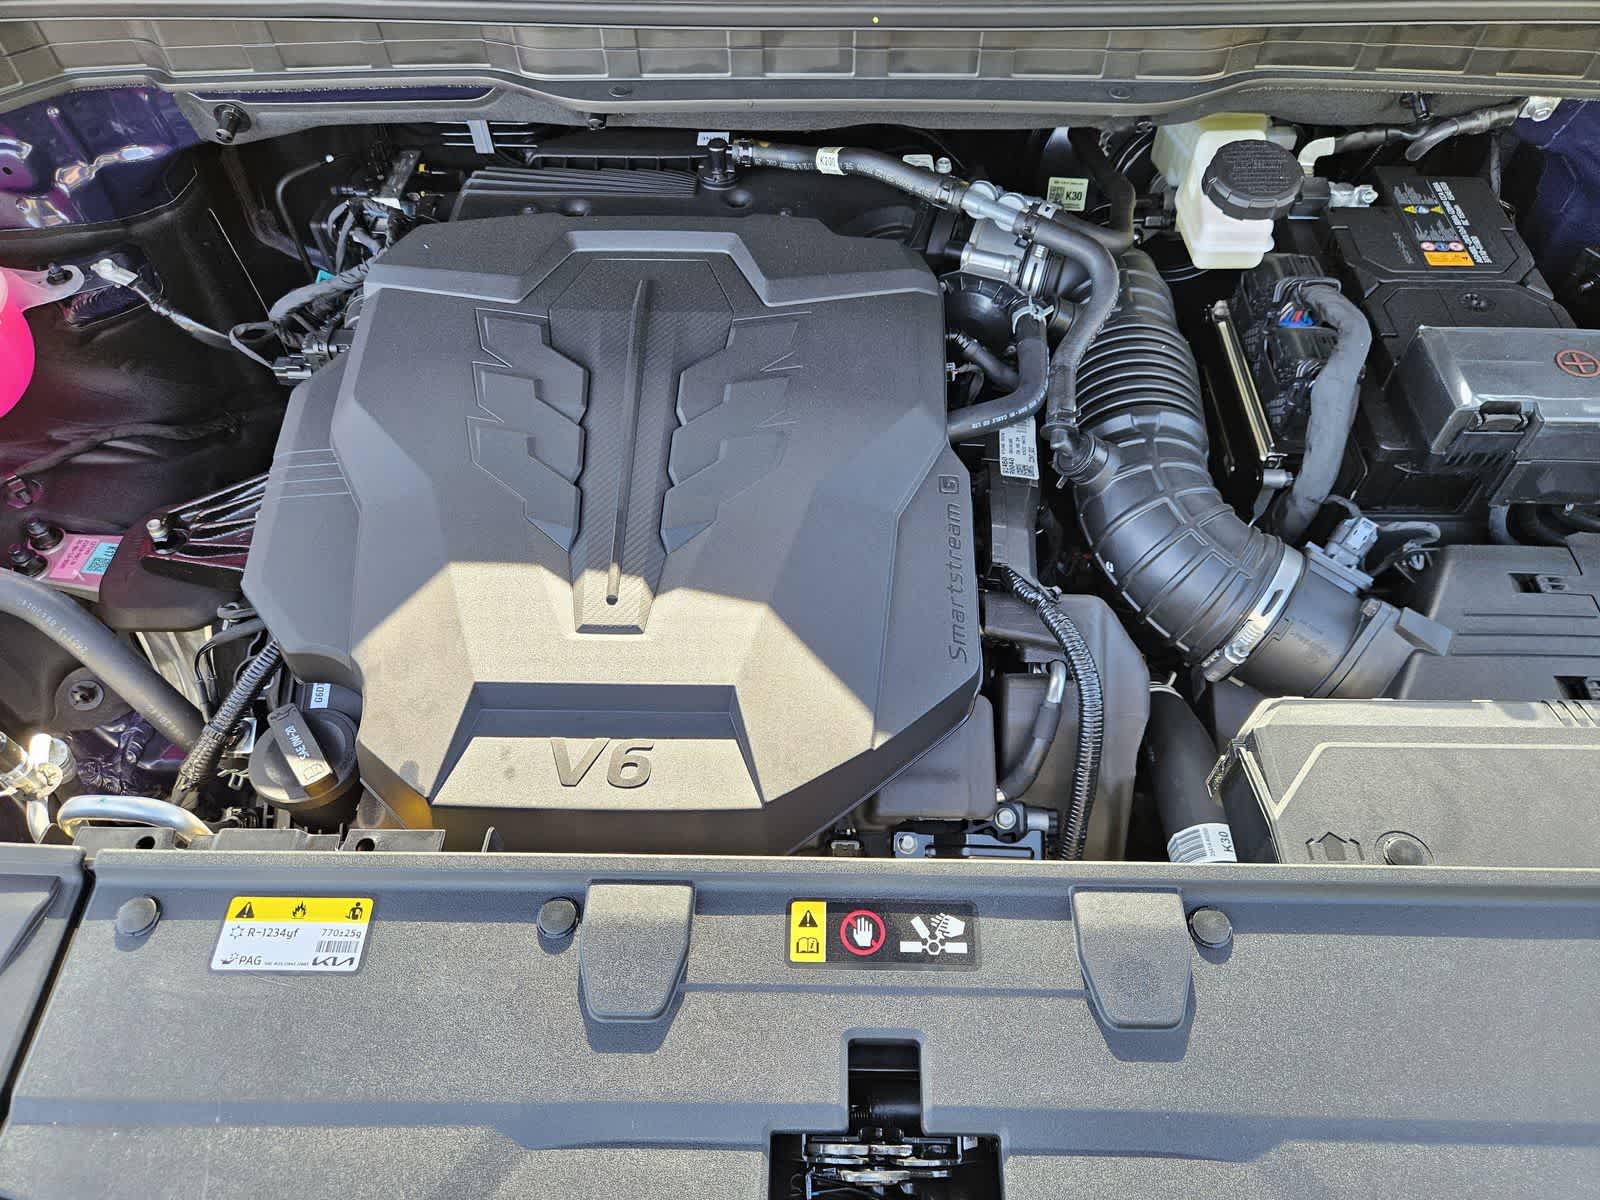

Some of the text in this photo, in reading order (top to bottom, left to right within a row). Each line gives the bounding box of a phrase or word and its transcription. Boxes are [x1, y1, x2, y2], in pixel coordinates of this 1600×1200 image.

[1065, 191, 1083, 201] K30
[945, 503, 967, 664] Smartstream
[295, 745, 310, 761] SAE
[550, 737, 655, 790] V6
[1217, 831, 1234, 853] K30
[247, 927, 301, 940] R-1234yf
[238, 955, 262, 966] PAG
